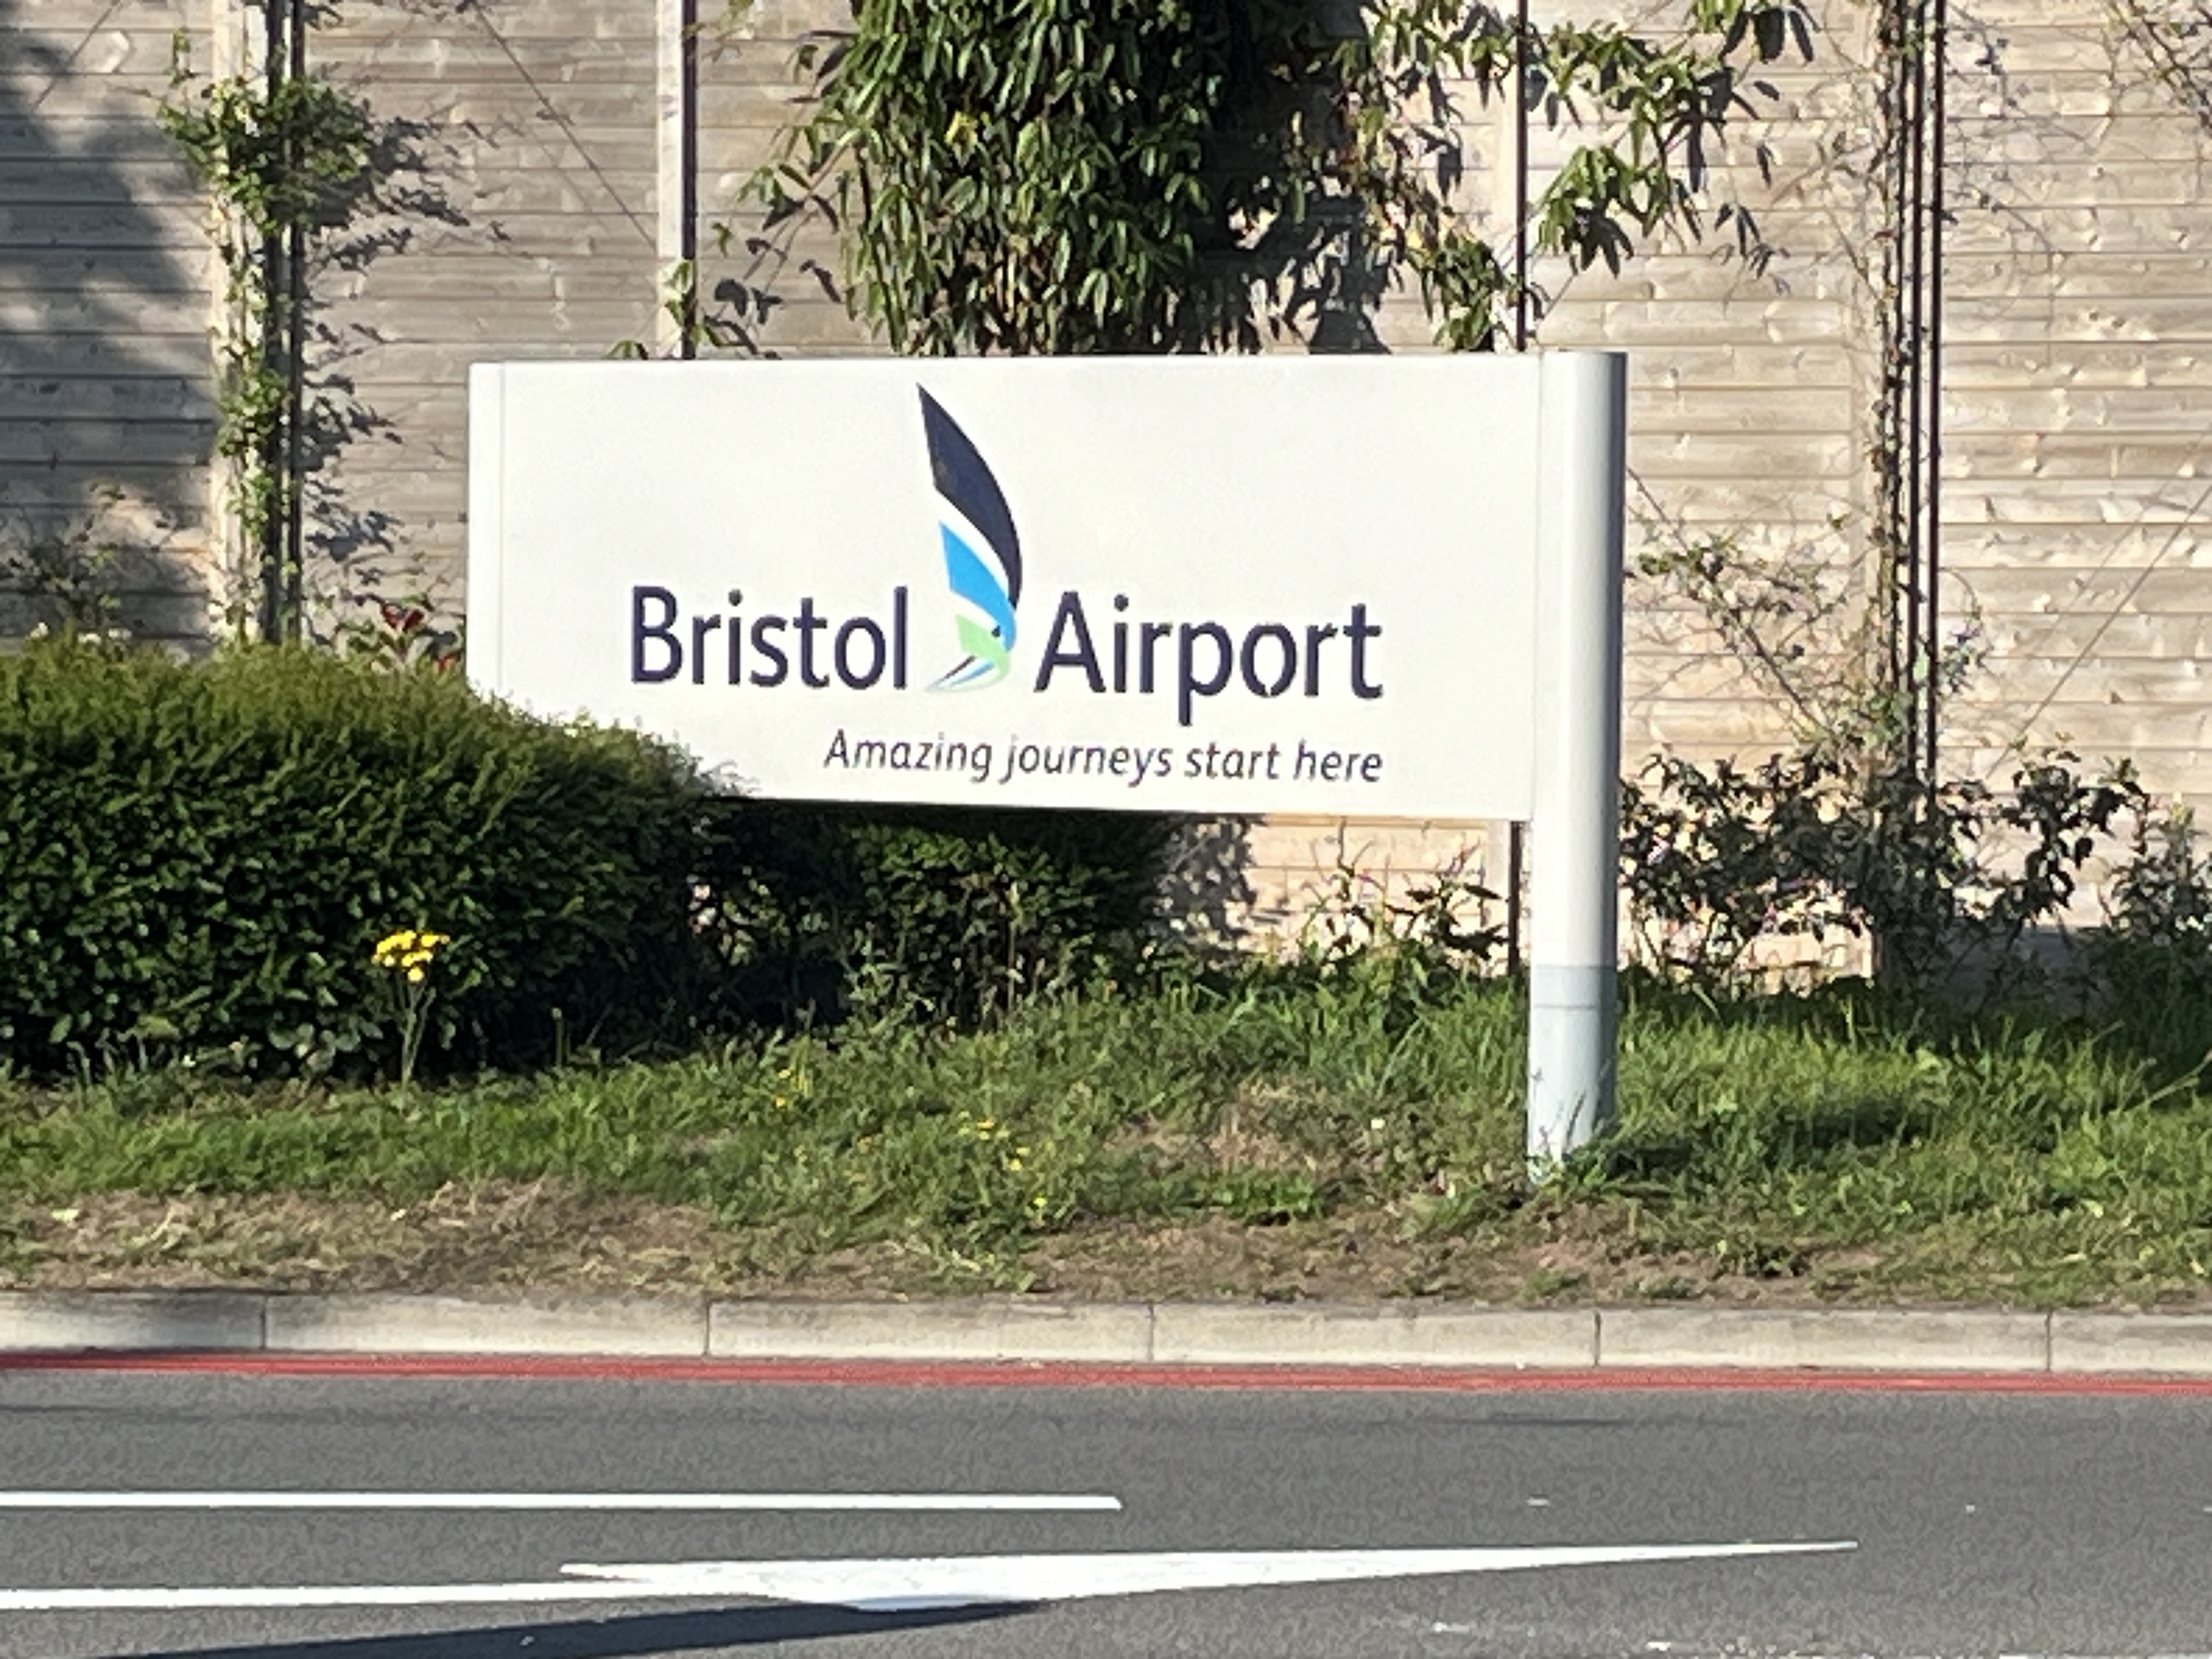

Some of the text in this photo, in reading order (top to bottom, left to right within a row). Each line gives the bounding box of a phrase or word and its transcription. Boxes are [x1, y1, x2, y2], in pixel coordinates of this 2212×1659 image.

[630, 585, 1384, 727] Bristol Airport
[823, 729, 1383, 788] Amazing journeys start here
